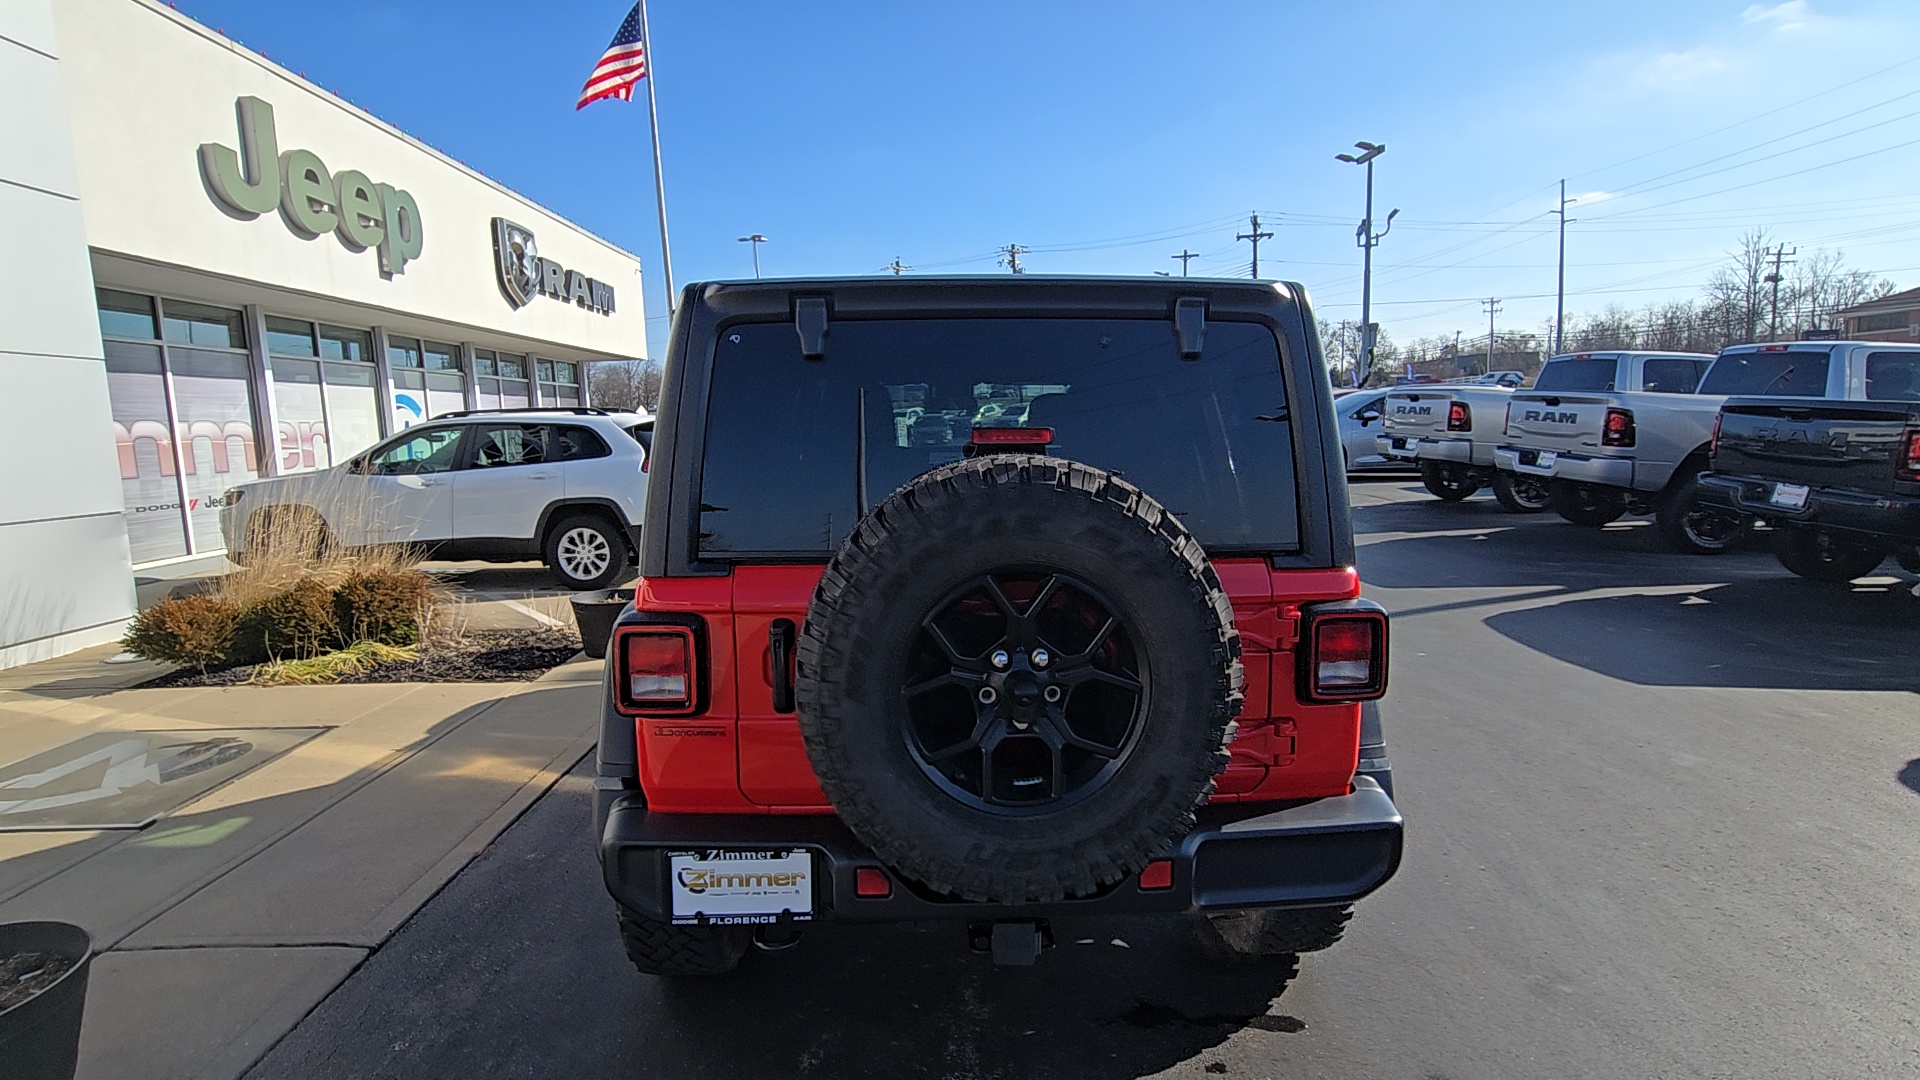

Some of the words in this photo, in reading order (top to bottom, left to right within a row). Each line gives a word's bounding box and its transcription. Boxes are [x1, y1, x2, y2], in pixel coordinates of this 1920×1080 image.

[199, 95, 423, 275] Jeep
[540, 257, 616, 315] RAM
[1395, 405, 1432, 416] RAM
[1524, 410, 1579, 425] RAM
[114, 419, 327, 479] mmer
[135, 503, 182, 513] DODG
[204, 495, 225, 509] Jee
[706, 849, 775, 861] Zimmer
[684, 868, 807, 889] Zimmer
[708, 915, 777, 926] FLORENCE
